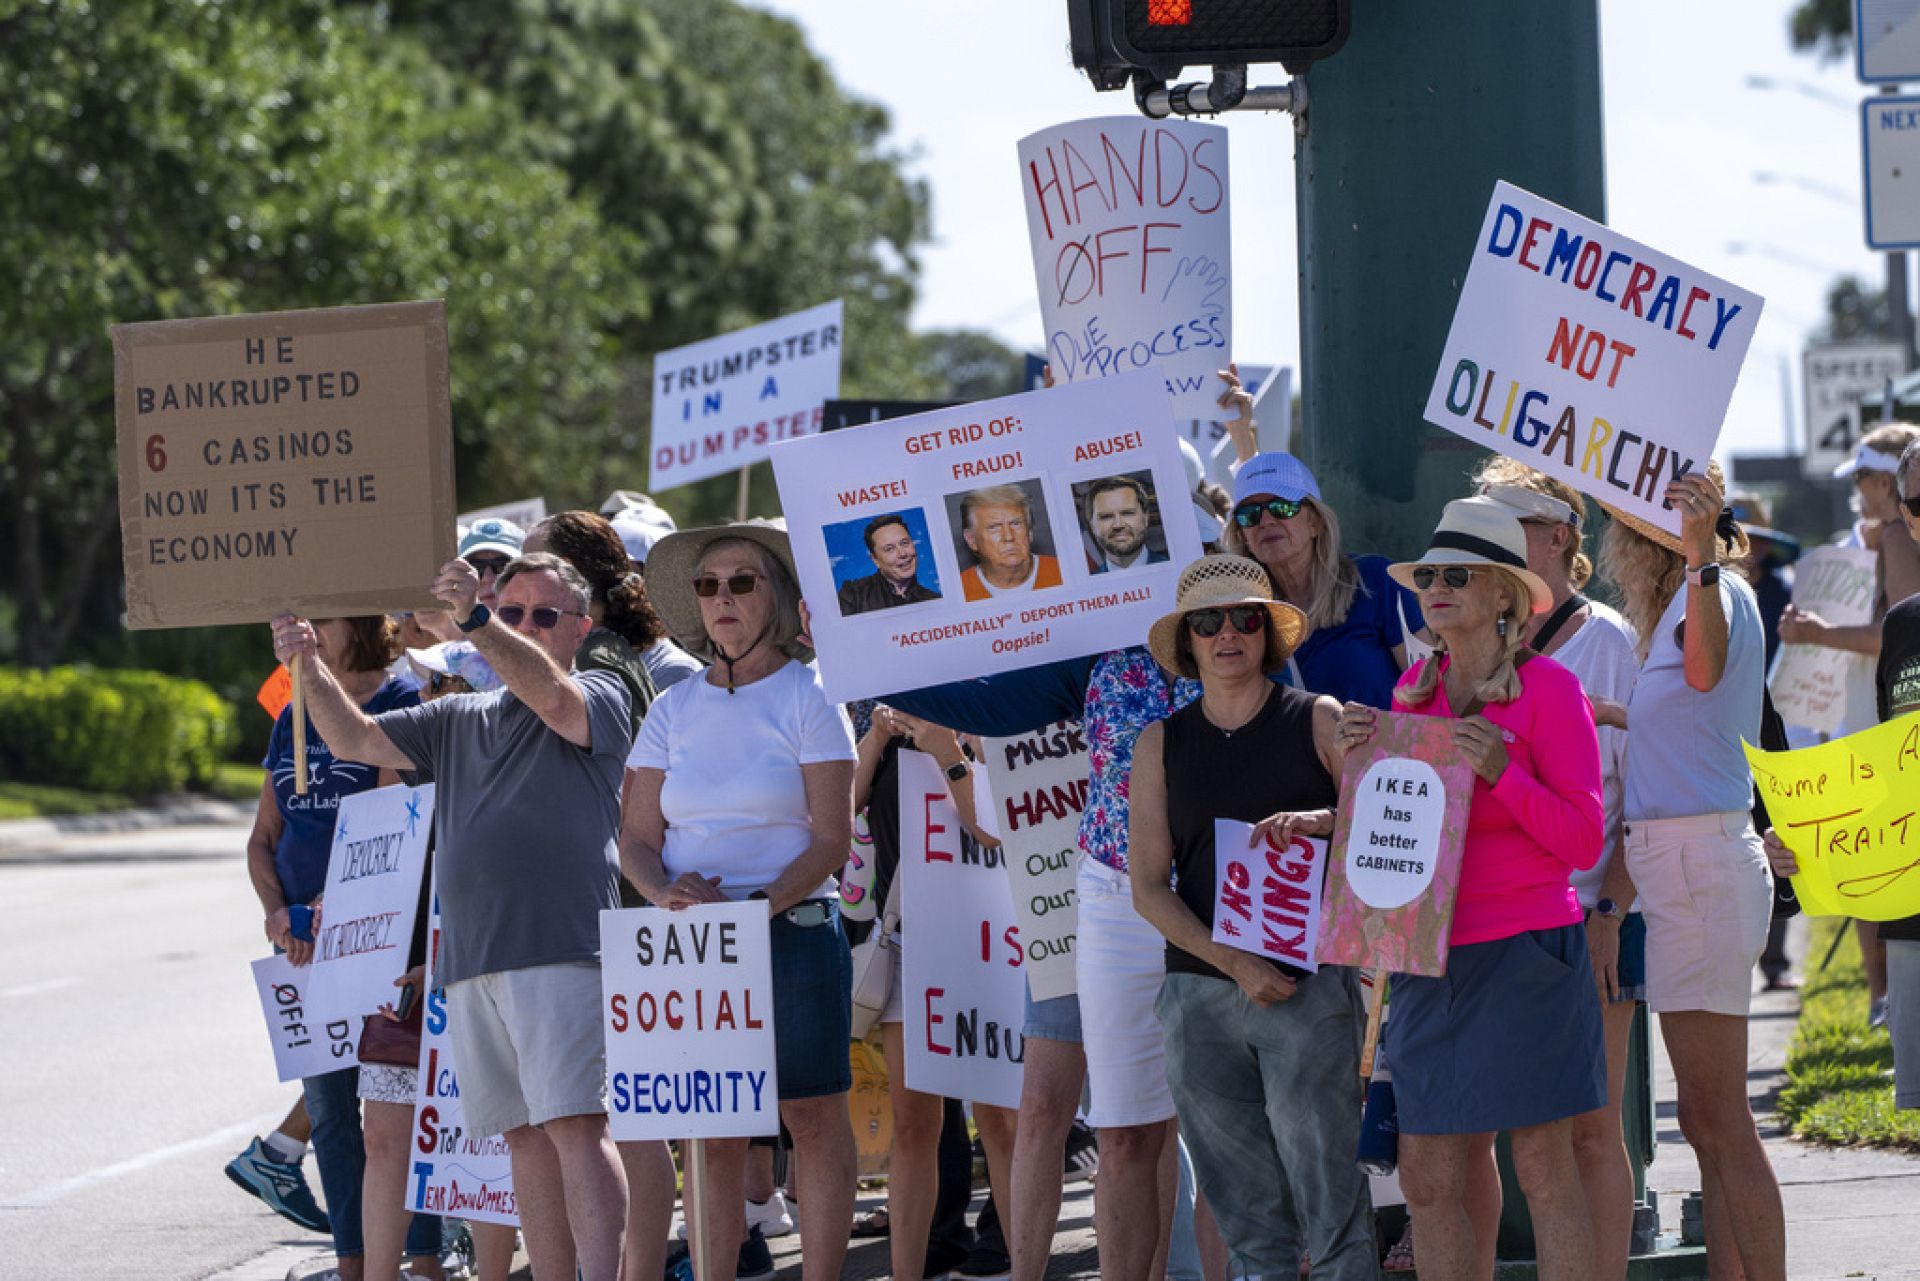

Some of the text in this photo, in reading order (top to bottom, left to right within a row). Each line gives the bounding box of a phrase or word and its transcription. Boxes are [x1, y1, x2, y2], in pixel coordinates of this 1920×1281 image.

[1881, 110, 1920, 130] NEX
[1029, 128, 1223, 240] HANDS
[1486, 203, 1742, 350] DEMOCRACY
[245, 336, 294, 364] HE
[660, 324, 839, 395] TRUMPSTER
[1052, 315, 1108, 384] DUE
[1546, 316, 1636, 389] NOT
[136, 371, 360, 415] BANKRUPTED
[683, 376, 779, 421] IN A
[145, 429, 353, 472] 6 CASINOS
[905, 416, 1023, 455] GET RID OF:
[1073, 431, 1143, 463] ABUSE!
[1445, 358, 1694, 511] OLIGARCHY
[952, 451, 1023, 480] FRAUD!
[144, 474, 376, 517] NOW ITS THE
[838, 479, 908, 508] WASTE!
[150, 527, 297, 564] ECONOMY
[1020, 602, 1075, 624] DEPORT
[1078, 593, 1118, 613] THEM
[1122, 586, 1152, 605] ALL!
[991, 628, 1049, 654] Oopsie!
[1005, 730, 1088, 771] MUSK
[1898, 723, 1920, 771] A
[1375, 777, 1429, 798] IKEA
[1383, 805, 1412, 822] has
[1369, 831, 1418, 850] better
[1026, 848, 1075, 877] Our
[1356, 854, 1424, 875] CABINETS
[1262, 830, 1315, 962] KINGS
[636, 922, 738, 966] SAVE
[981, 920, 1024, 968] IS
[1028, 934, 1077, 961] Our
[610, 988, 763, 1033] SOCIAL
[613, 1069, 766, 1114] SECURITY
